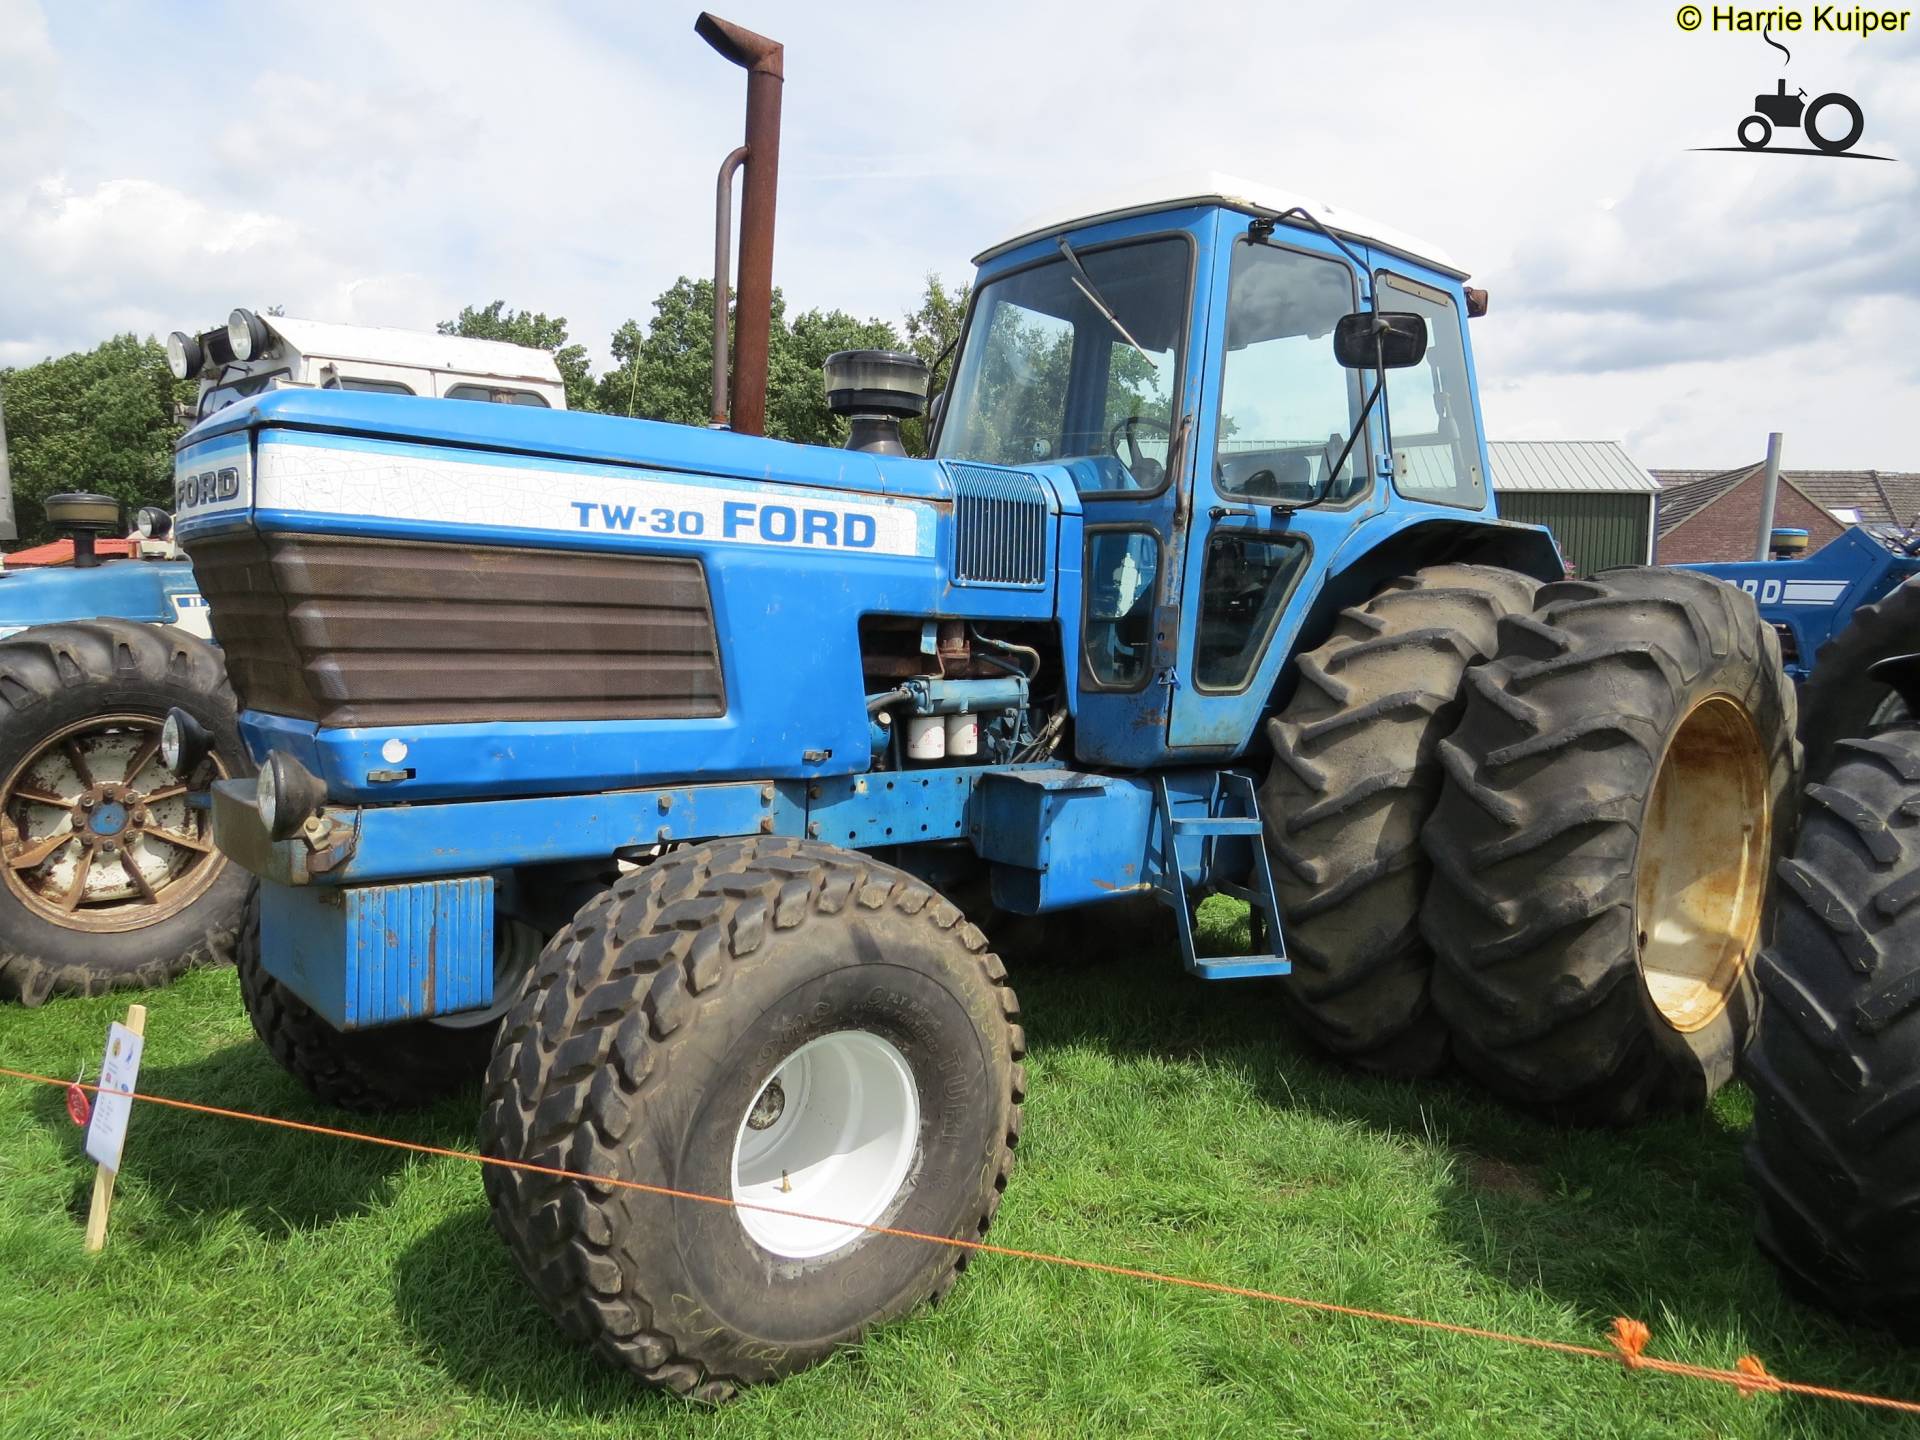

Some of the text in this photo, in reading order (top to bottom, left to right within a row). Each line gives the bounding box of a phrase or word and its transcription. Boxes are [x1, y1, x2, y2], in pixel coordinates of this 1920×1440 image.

[176, 466, 240, 512] FORD
[571, 501, 876, 548] TW-30 FORD
